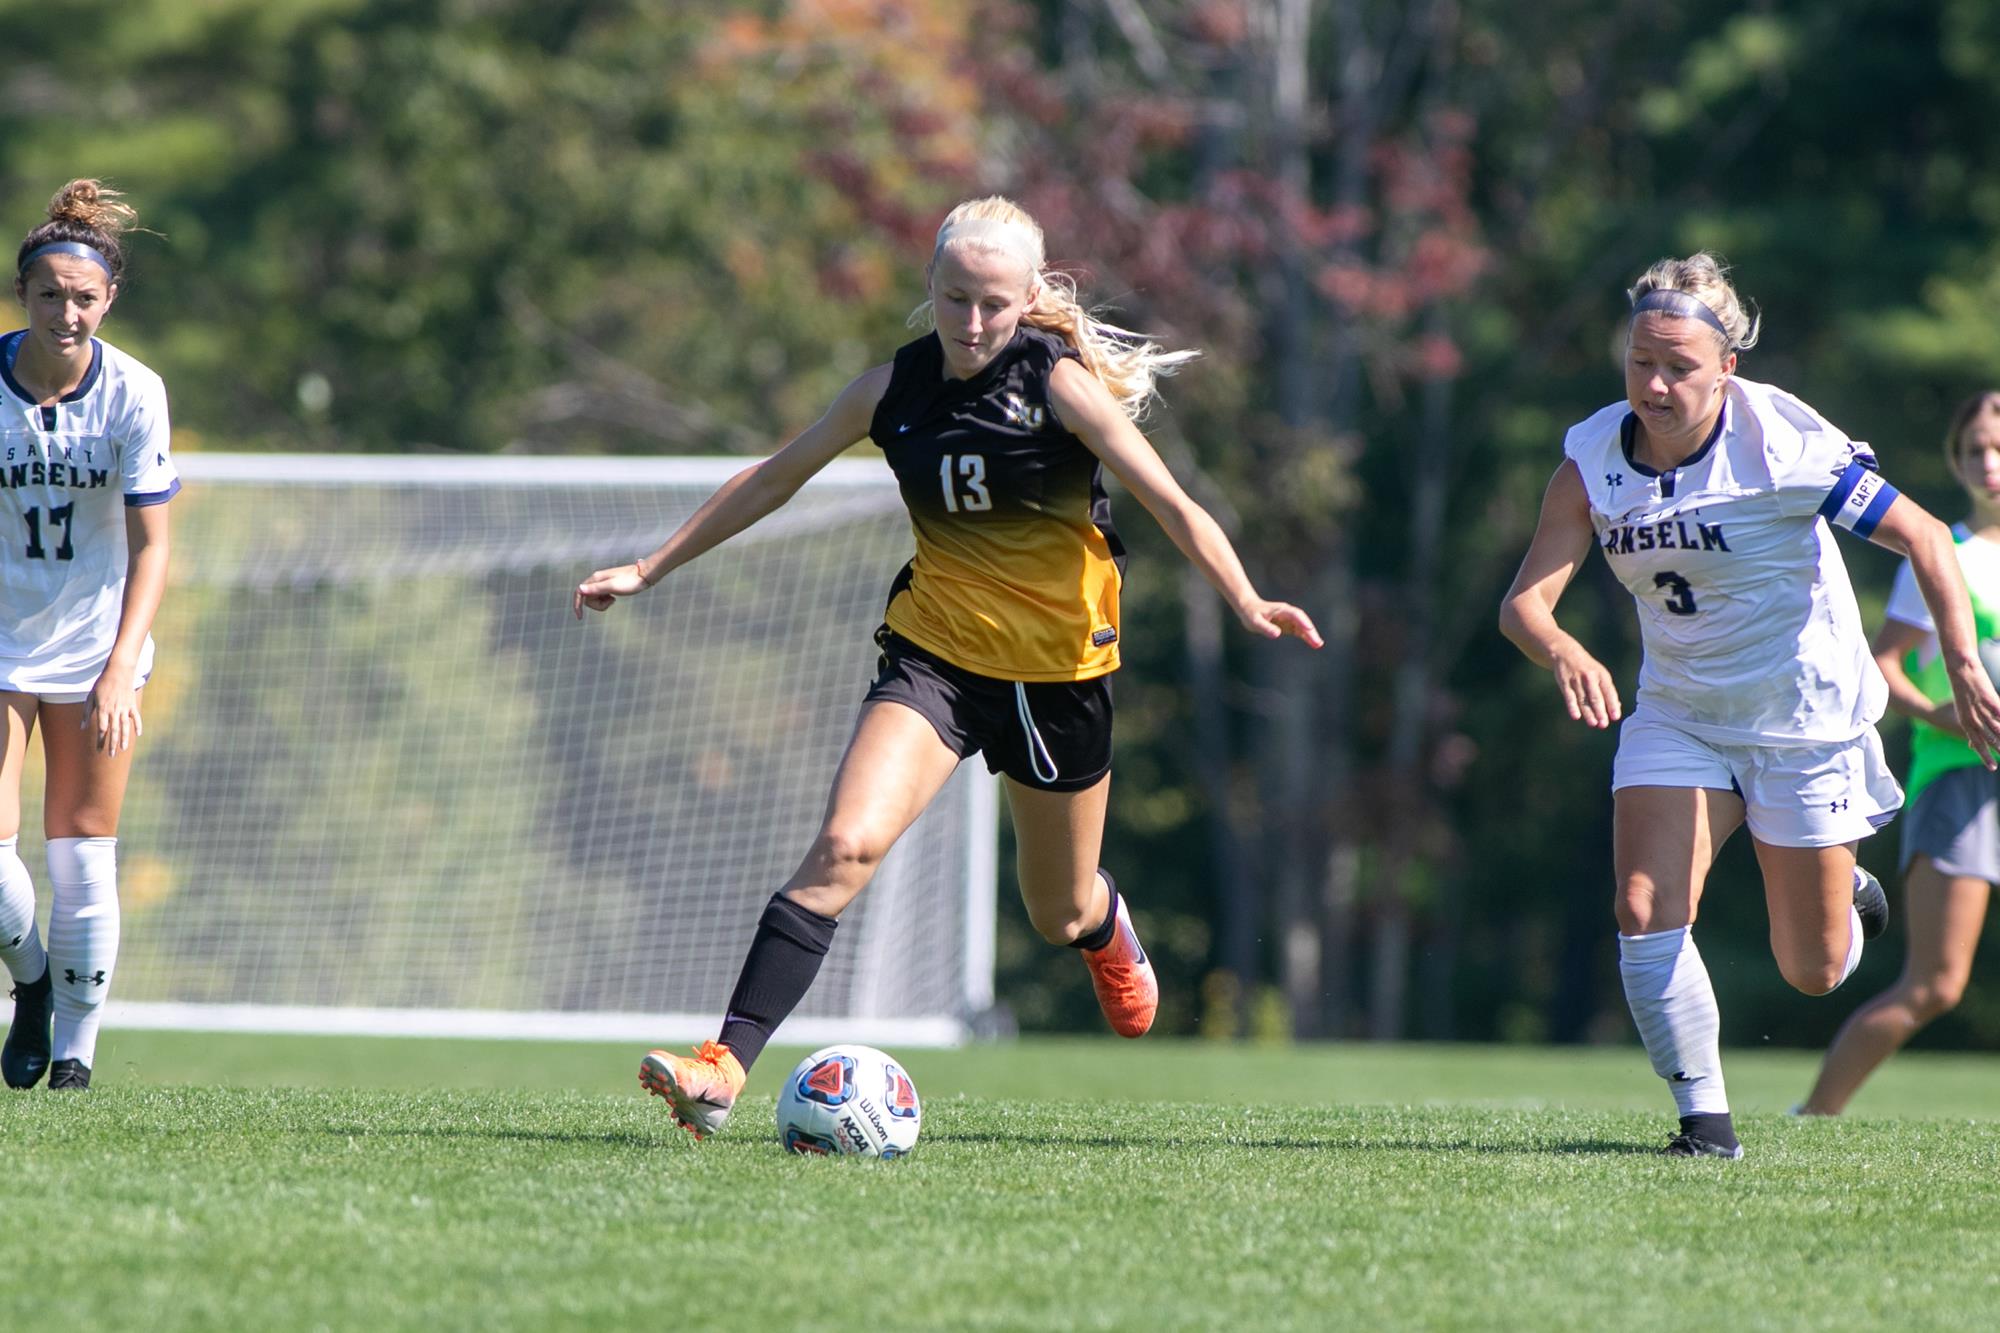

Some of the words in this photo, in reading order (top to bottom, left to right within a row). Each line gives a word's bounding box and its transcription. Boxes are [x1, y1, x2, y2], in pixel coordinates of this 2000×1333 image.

[7, 444, 93, 463] SAINT
[939, 454, 993, 513] 13
[24, 501, 74, 560] 17
[1652, 570, 1697, 616] 3
[840, 1116, 869, 1152] NCAA
[859, 1098, 888, 1142] Wilson
